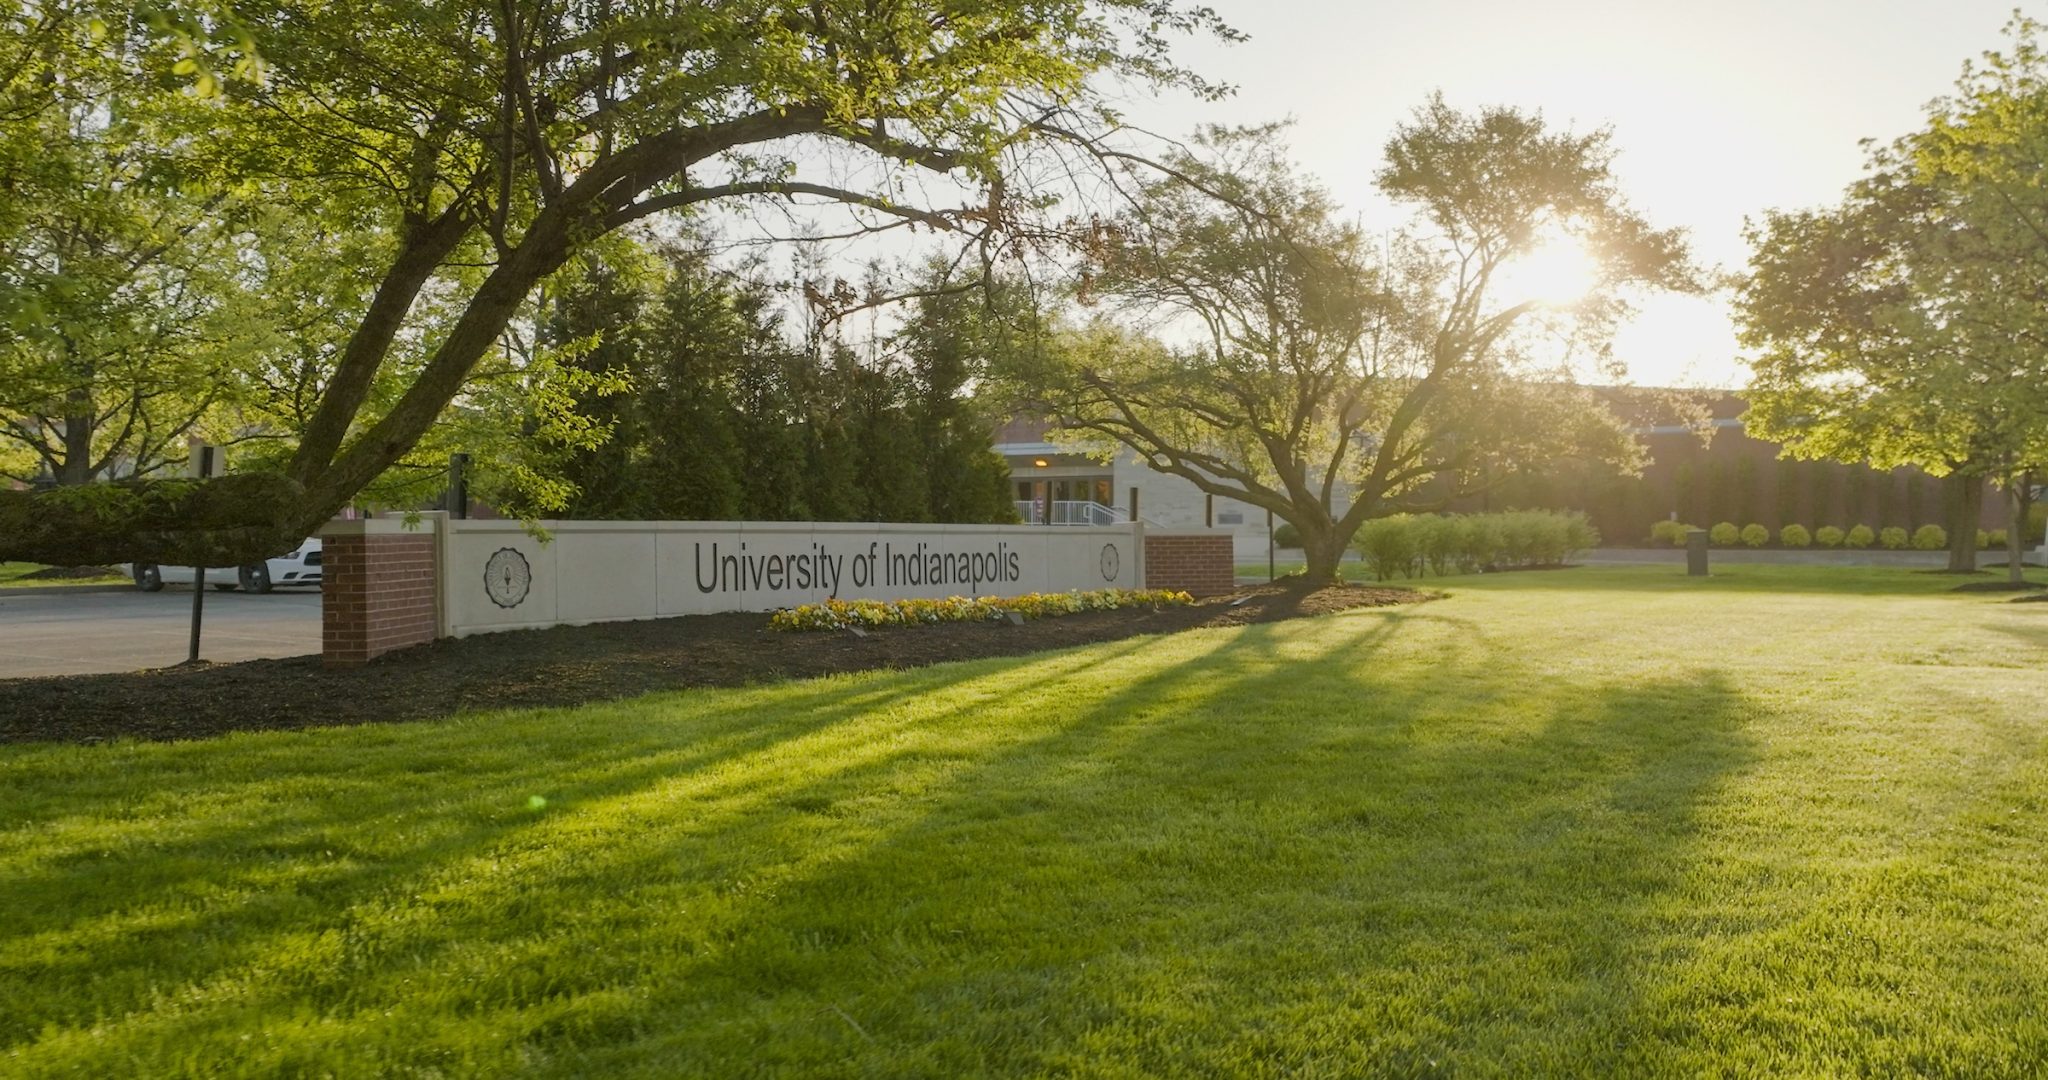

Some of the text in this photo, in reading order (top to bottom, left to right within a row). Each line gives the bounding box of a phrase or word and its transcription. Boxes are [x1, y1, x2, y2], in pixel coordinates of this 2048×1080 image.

[695, 542, 1020, 599] University of Indianapolis
